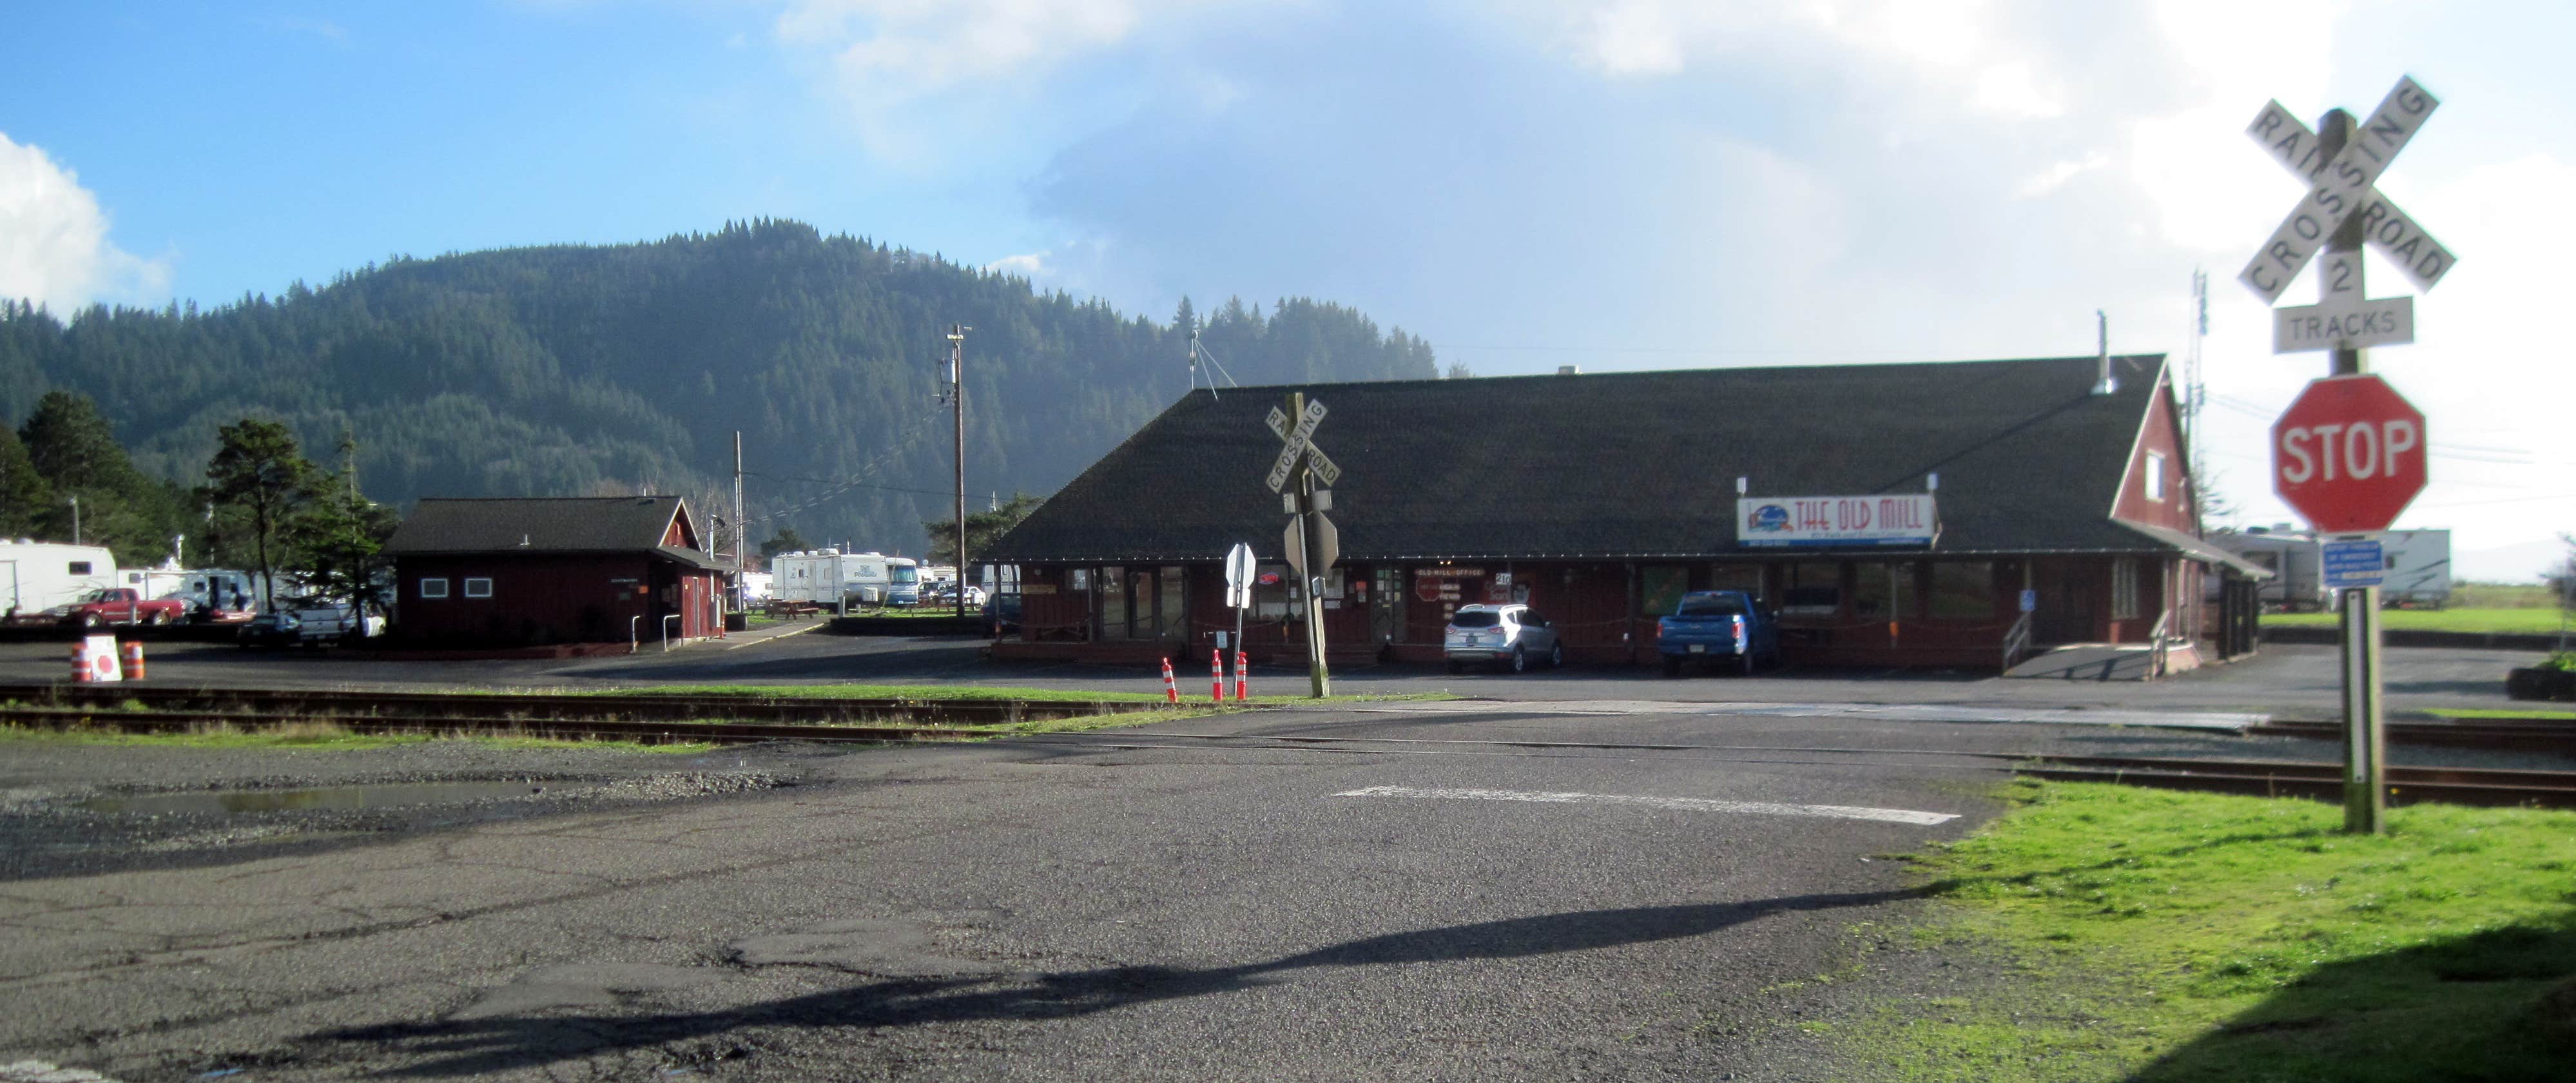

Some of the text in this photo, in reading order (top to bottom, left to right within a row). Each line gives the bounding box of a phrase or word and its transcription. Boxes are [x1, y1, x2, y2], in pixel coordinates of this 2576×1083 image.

[2251, 88, 2426, 293] CROSSING
[2361, 200, 2443, 281] ROAD
[2331, 260, 2351, 293] 2
[2290, 310, 2396, 340] TRACKS
[1269, 405, 1322, 488] CROSSING
[1308, 451, 1336, 481] ROAD
[2282, 420, 2416, 483] STOP
[1795, 498, 1923, 531] THE OLD MILL
